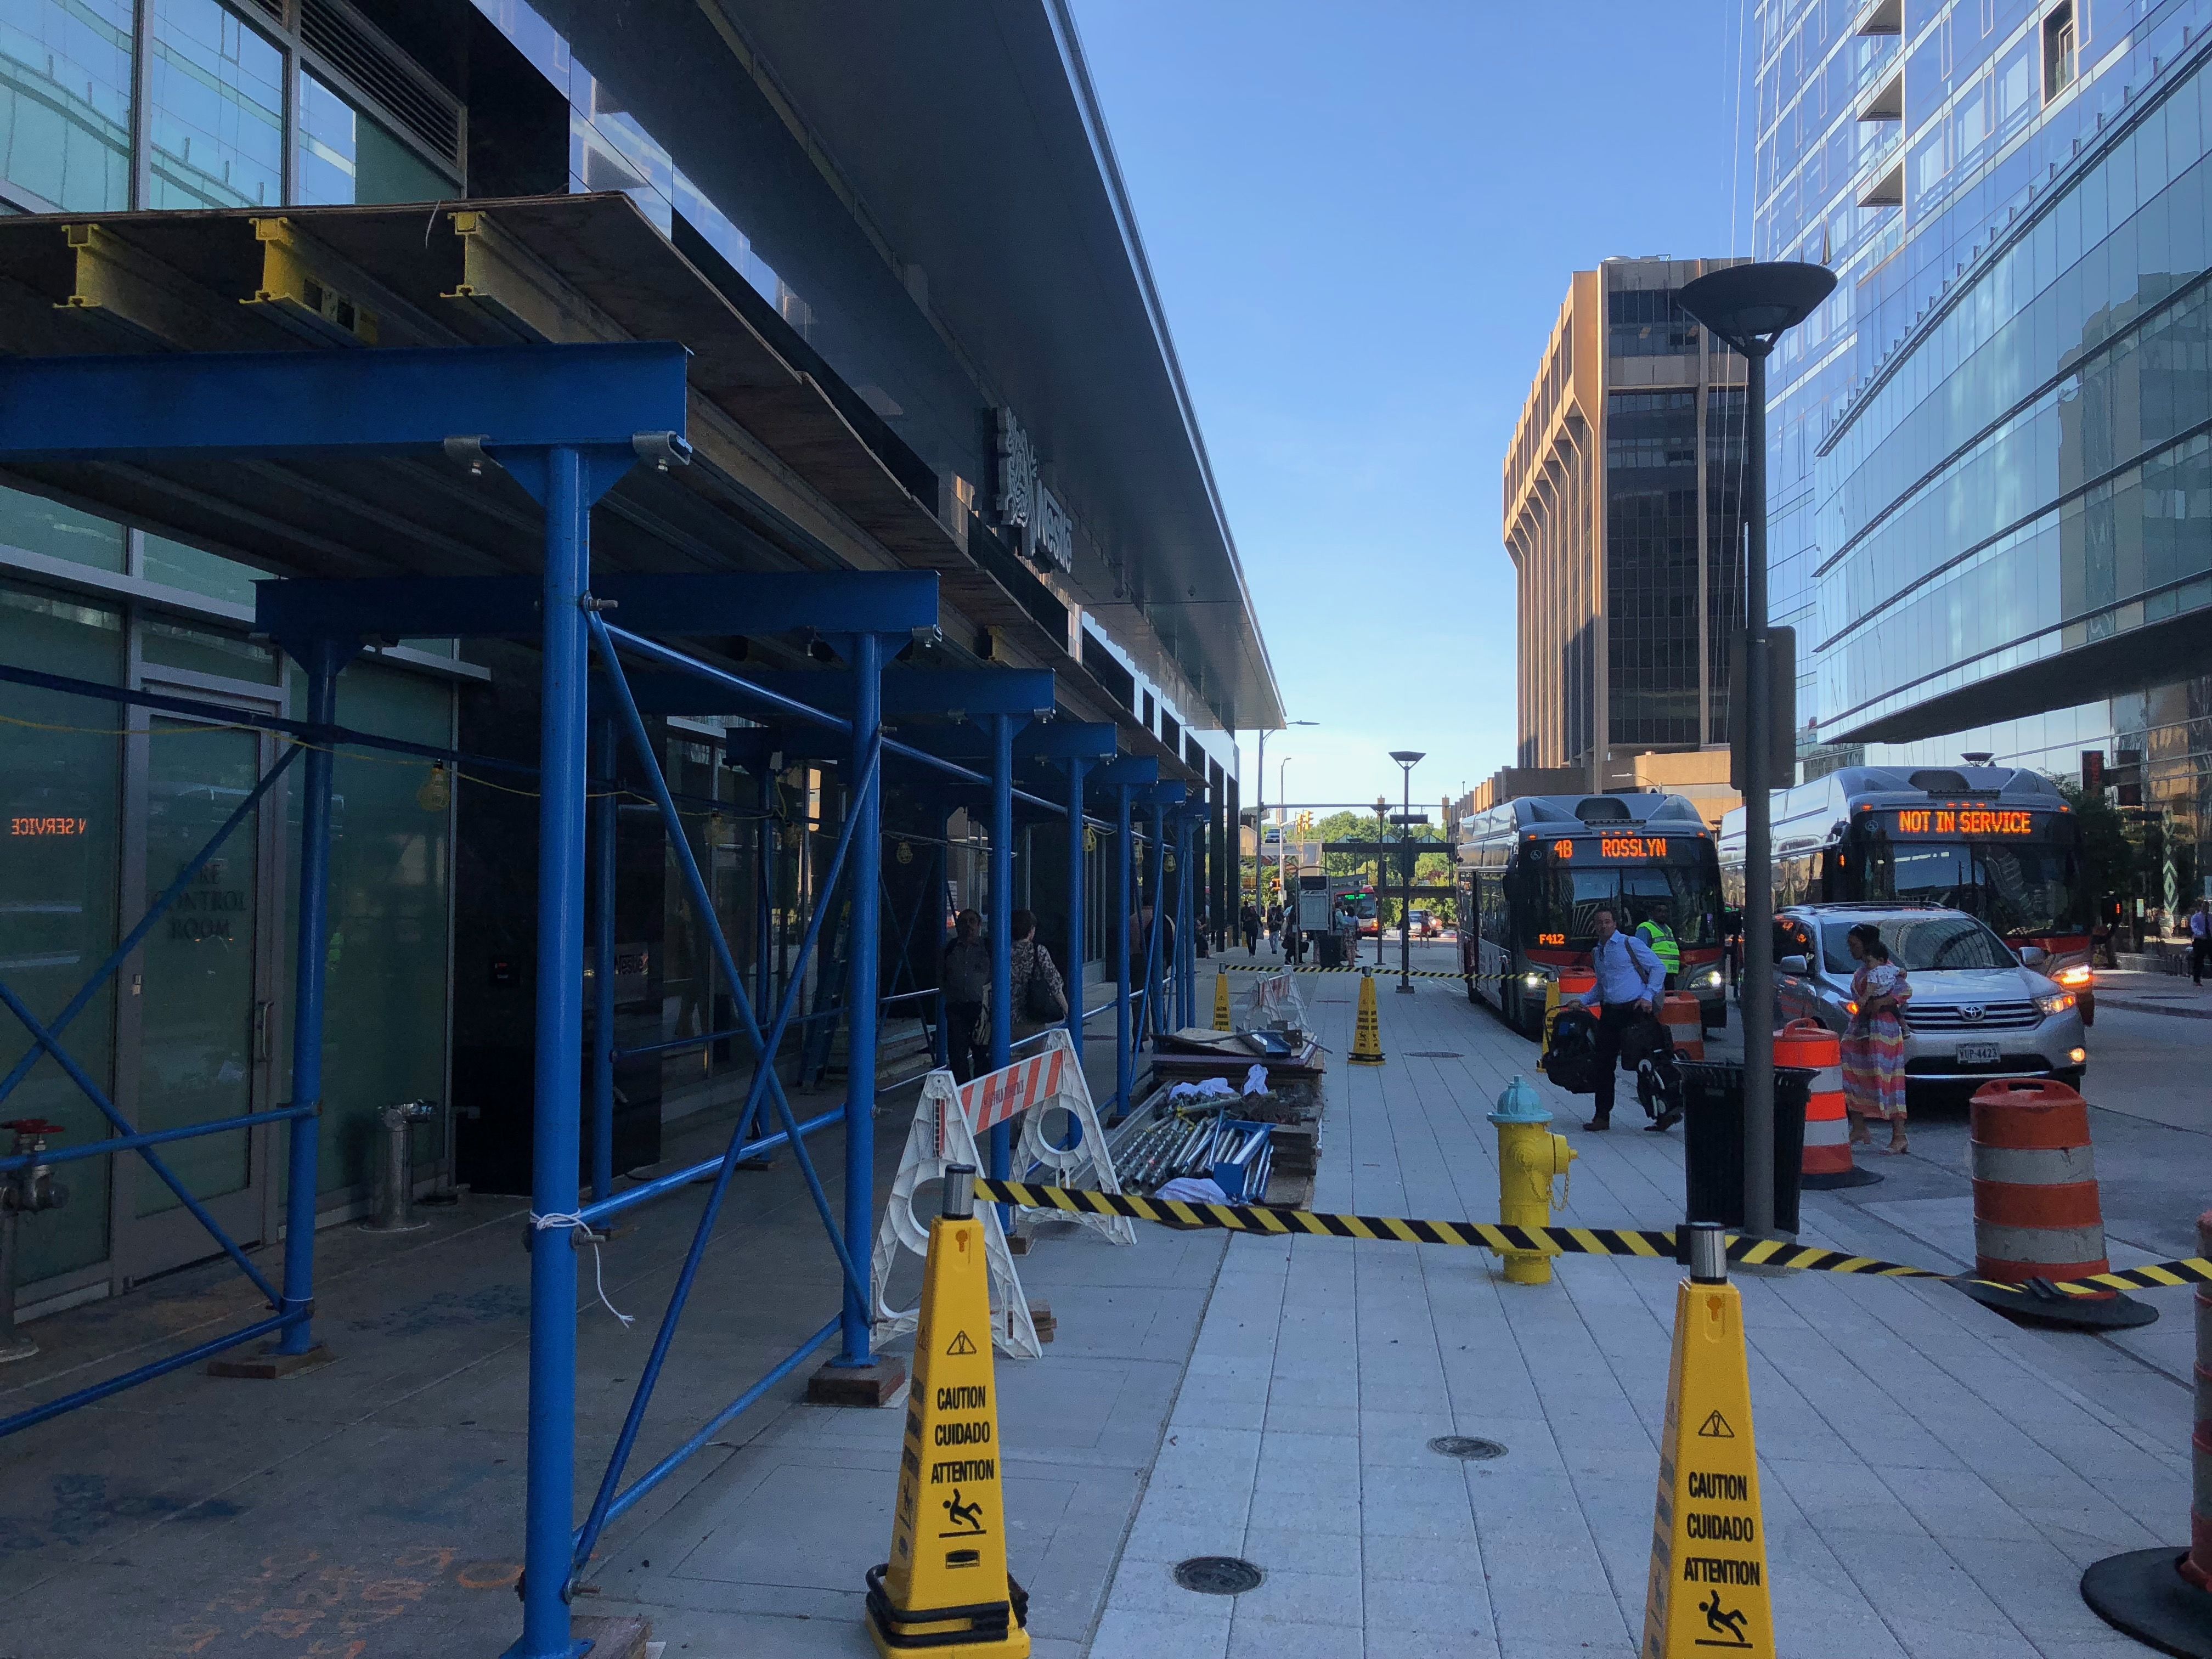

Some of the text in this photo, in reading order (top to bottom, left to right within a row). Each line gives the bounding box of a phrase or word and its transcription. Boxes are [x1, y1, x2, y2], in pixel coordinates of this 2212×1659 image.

[1899, 811, 2032, 834] NOT IN SERVICE
[1554, 838, 1667, 859] 4B ROSSLYN
[1539, 934, 1565, 945] F412
[937, 1386, 986, 1412] CAUTION
[934, 1421, 991, 1447] CUIDADO
[931, 1459, 995, 1485] ATTENTION
[1688, 1471, 1748, 1502] CAUTION
[1686, 1513, 1754, 1543] CUIDADO
[1684, 1556, 1761, 1587] ATTENTION
